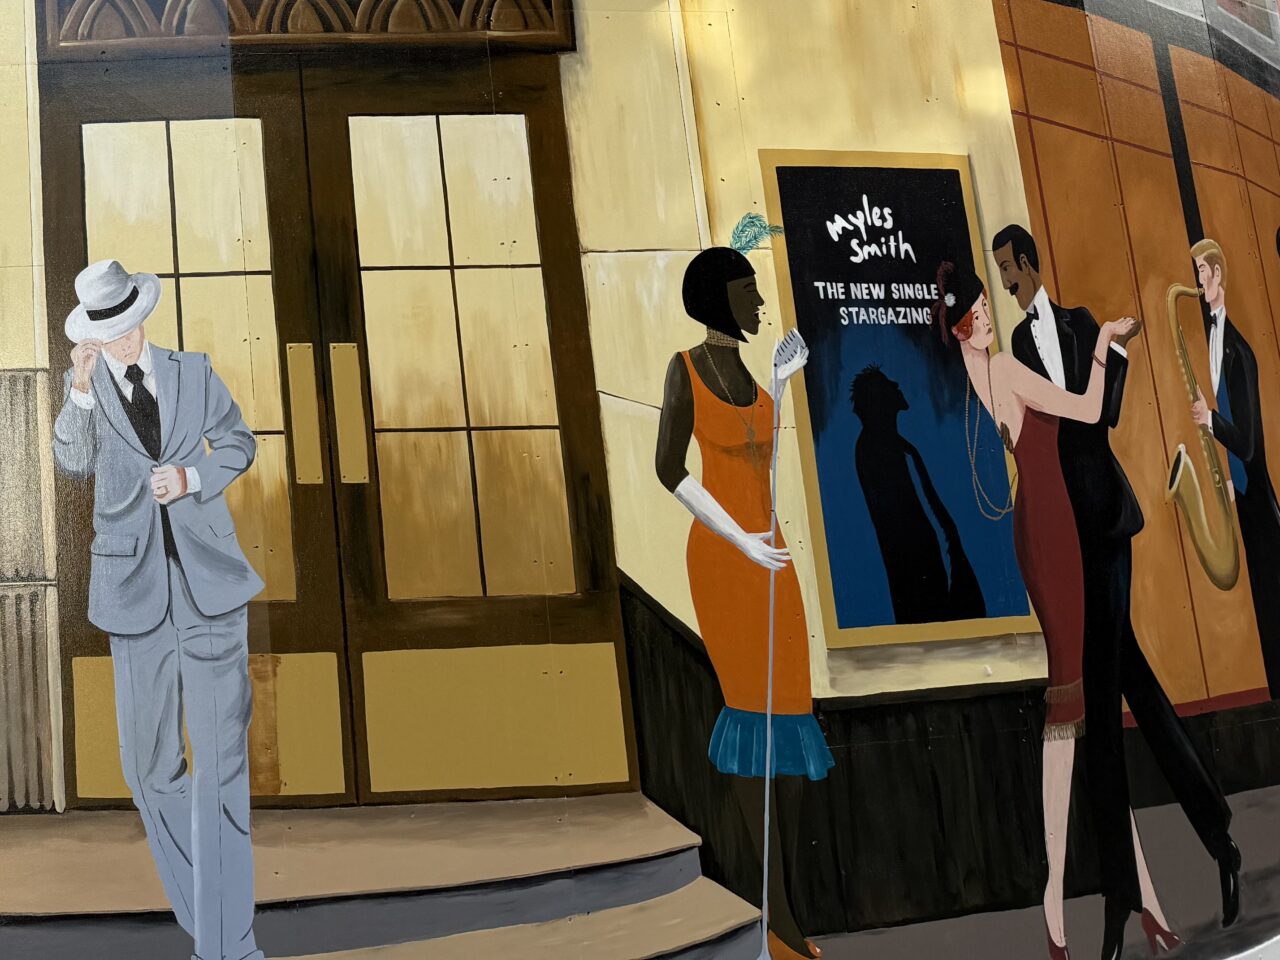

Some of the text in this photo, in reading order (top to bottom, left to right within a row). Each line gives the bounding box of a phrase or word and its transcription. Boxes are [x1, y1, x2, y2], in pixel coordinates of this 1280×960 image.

[850, 230, 917, 264] Smith
[814, 281, 939, 300] THE NEW SINGLE
[839, 306, 933, 326] STARGAZING
